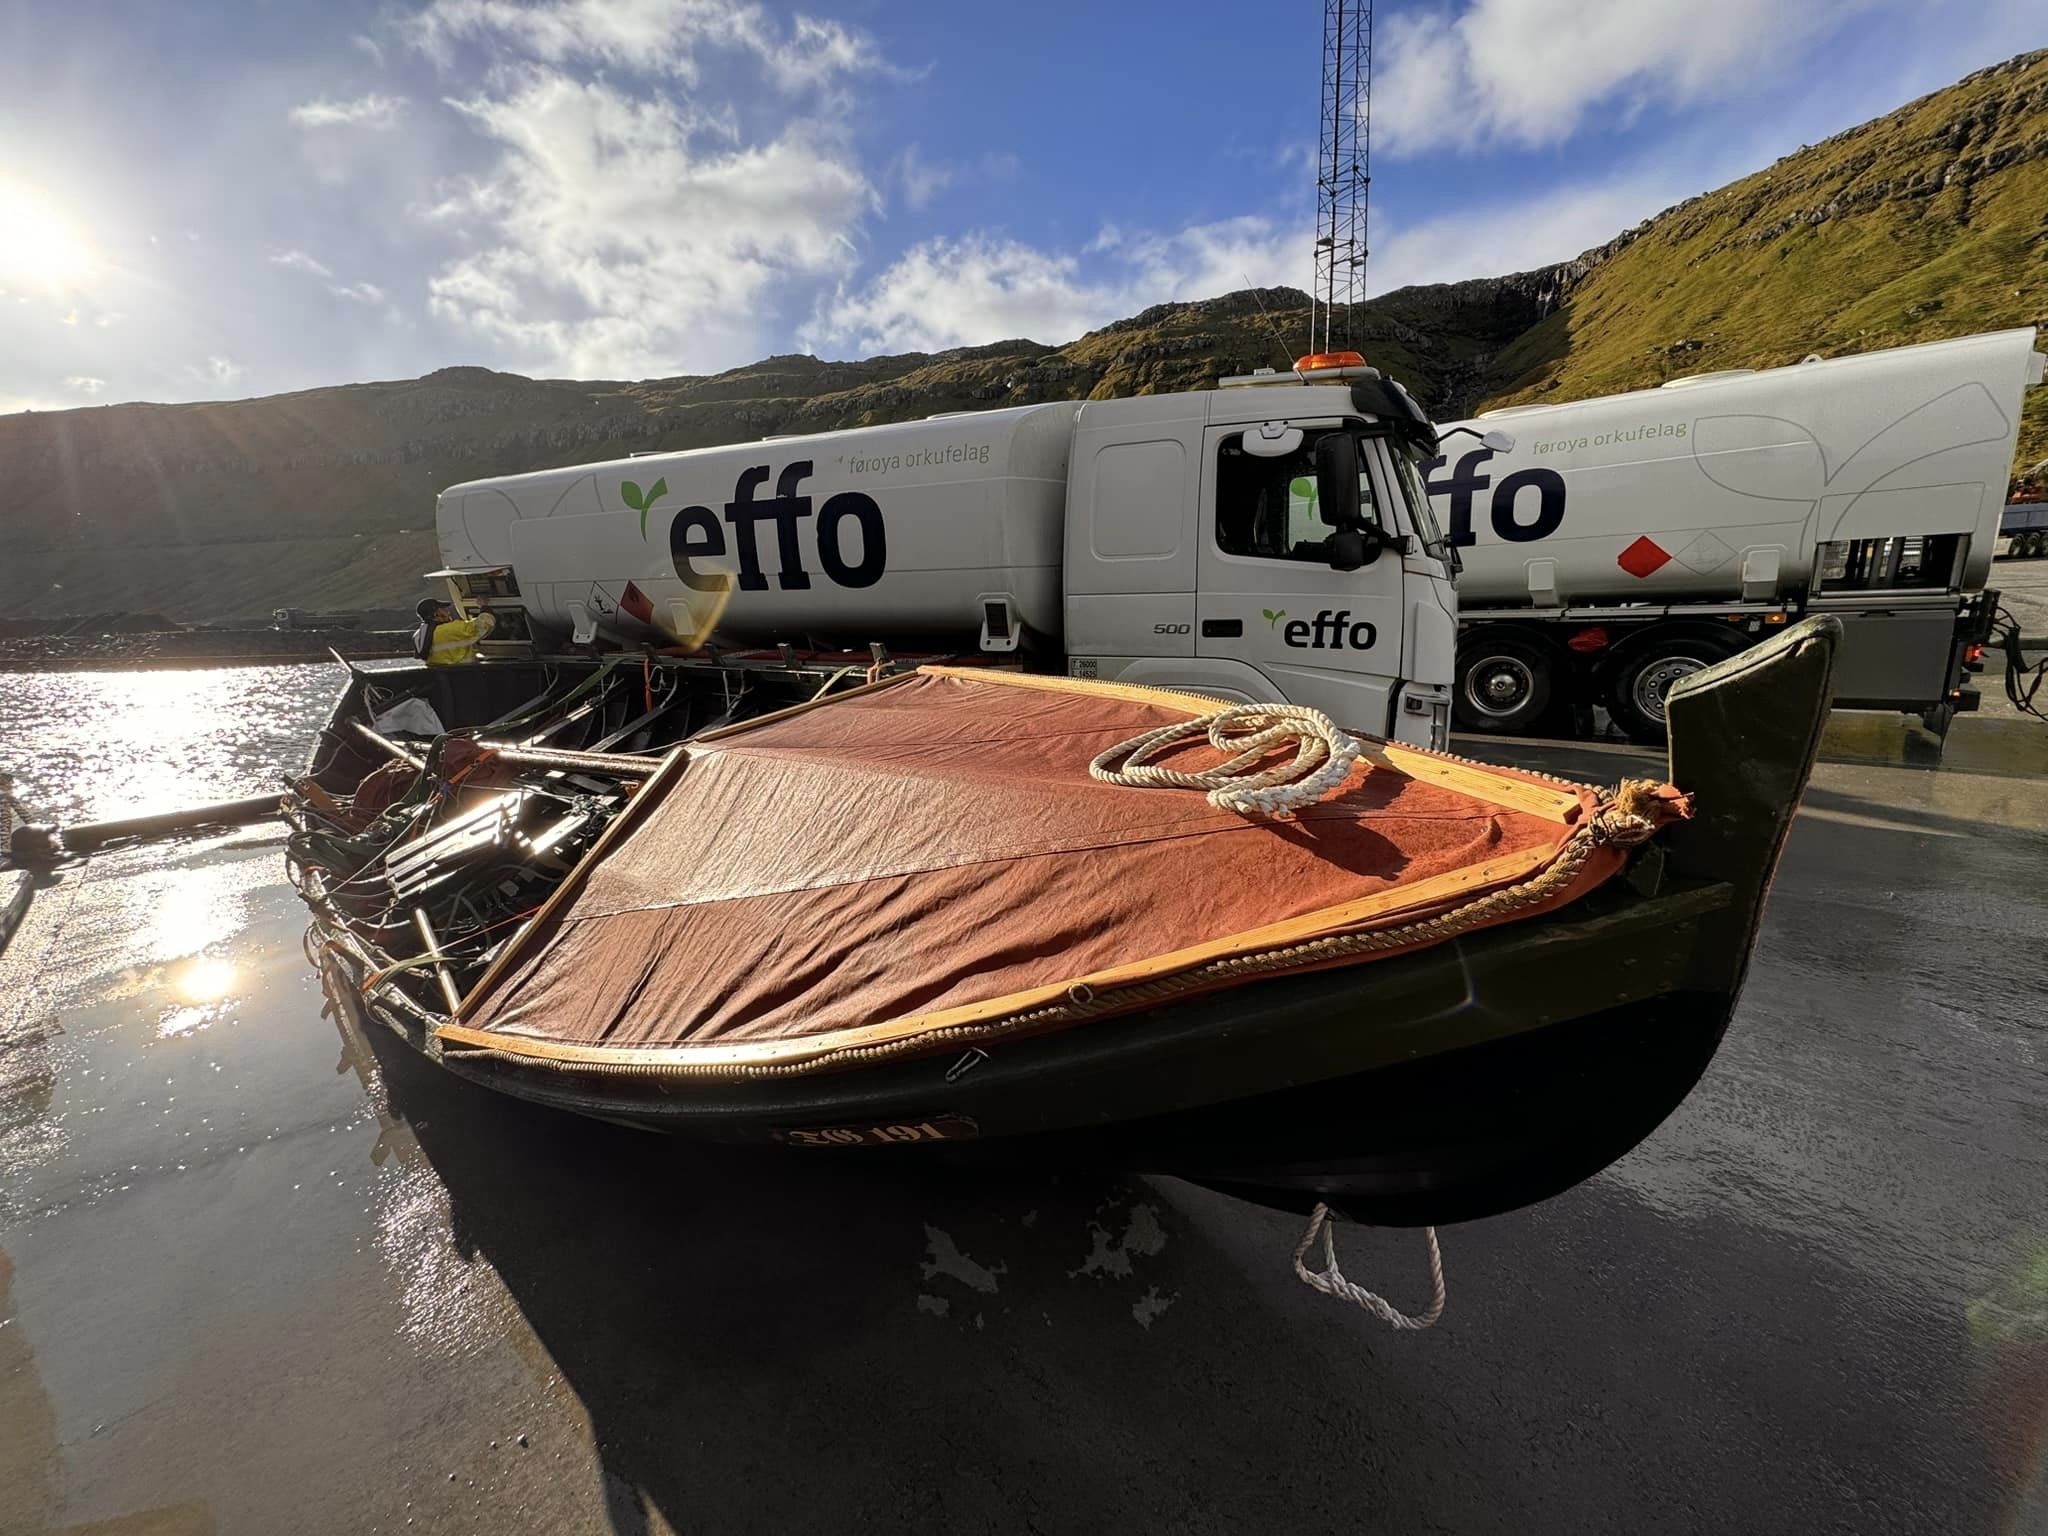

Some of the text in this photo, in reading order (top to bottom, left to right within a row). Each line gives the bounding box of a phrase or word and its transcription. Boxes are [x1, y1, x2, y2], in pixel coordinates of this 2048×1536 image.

[1533, 423, 1688, 455] føroya orkufelag
[849, 443, 990, 474] føroya orkufelag
[1417, 447, 1567, 547] ffo
[670, 460, 887, 591] effo
[1153, 623, 1191, 635] 500
[1284, 610, 1377, 650] effo
[867, 1123, 951, 1142] 191
